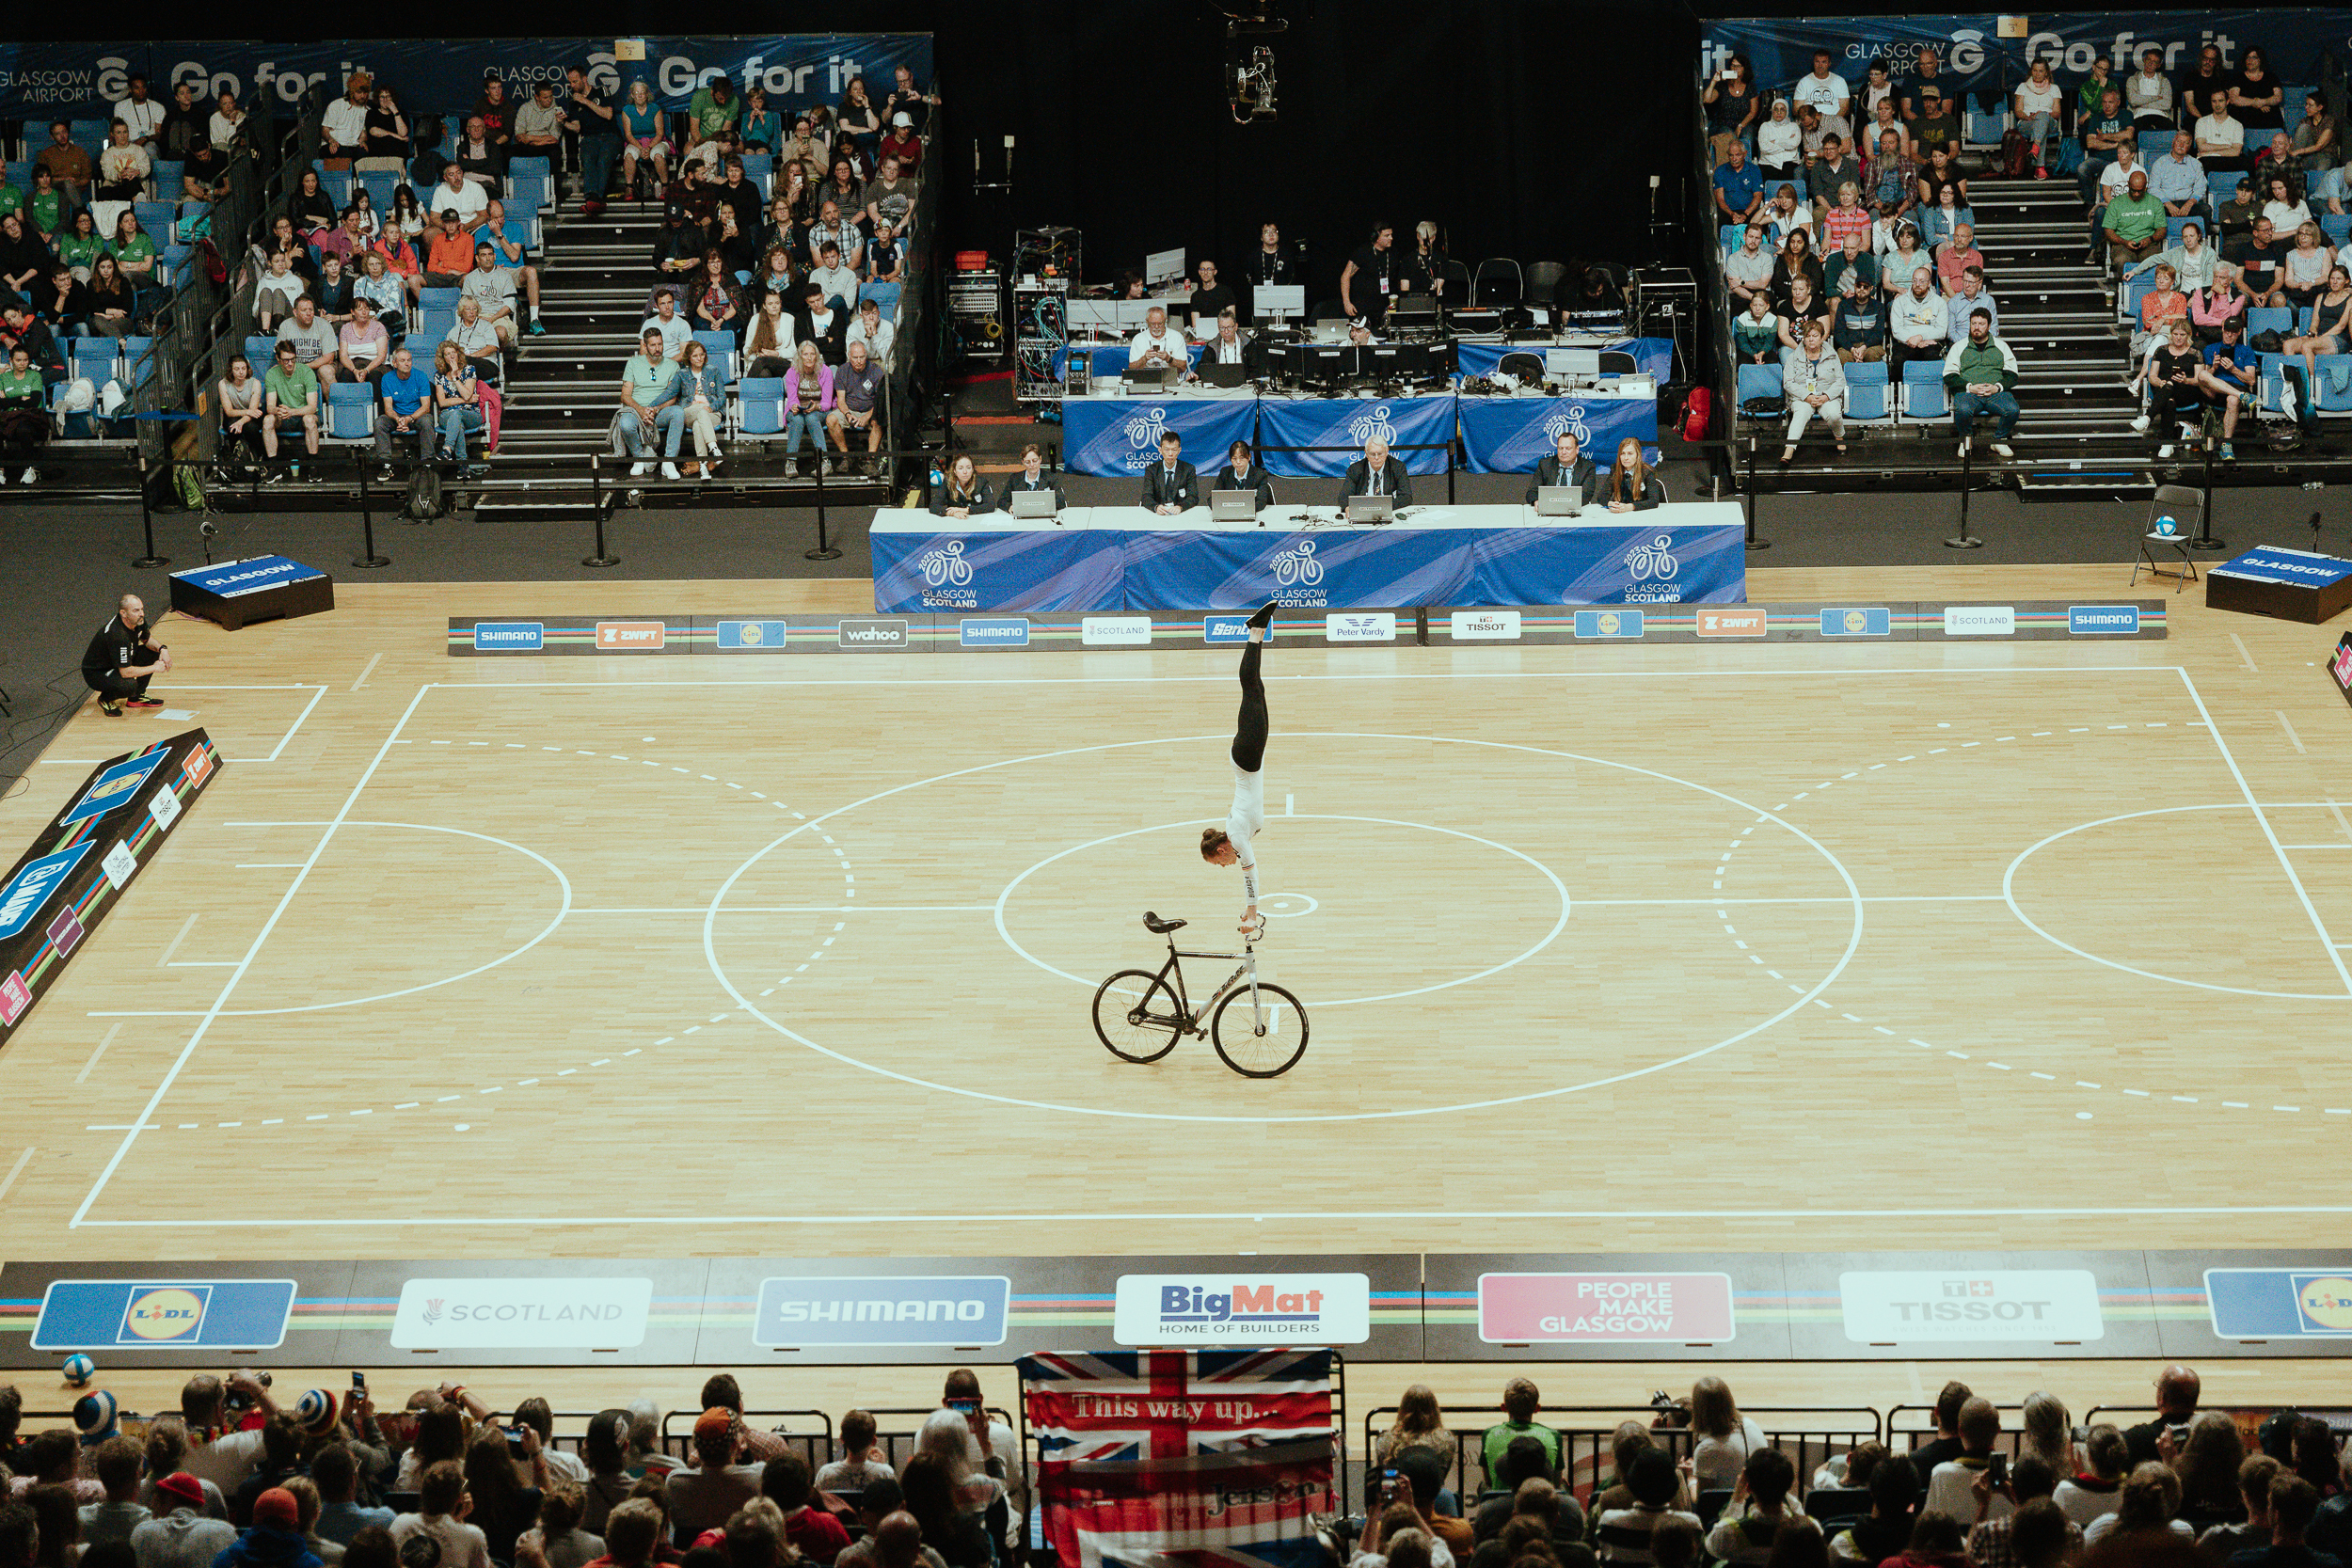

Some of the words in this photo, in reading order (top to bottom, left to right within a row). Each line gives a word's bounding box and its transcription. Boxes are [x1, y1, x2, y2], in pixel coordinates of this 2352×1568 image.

[2026, 32, 2096, 72] Go
[741, 56, 814, 94] for
[829, 55, 862, 94] it
[23, 87, 93, 103] AIRPORT
[1662, 306, 1670, 314] 2
[1123, 418, 1139, 436] 2023
[1348, 417, 1363, 436] 2023
[1543, 416, 1559, 435] 2023
[918, 551, 935, 572] 2023
[1269, 551, 1286, 572] 2023
[1624, 546, 1641, 567] 2023
[205, 563, 295, 586] GLASGOW
[2242, 558, 2340, 577] GLASGOW
[922, 589, 977, 599] GLASGOW
[1271, 589, 1327, 599] GLASGOW
[1624, 583, 1681, 594] GLASGOW
[923, 597, 977, 608] SCOTLAND
[1278, 598, 1327, 608] COTLAND
[1625, 594, 1681, 603] SCOTLAND
[1466, 623, 1506, 631] TISSOT
[1722, 618, 1758, 628] ZWIFT
[2075, 615, 2133, 625] SHIMANO
[481, 631, 537, 641] SHIMANO
[621, 630, 657, 641] ZWIFT
[847, 626, 900, 641] wahoo
[966, 627, 1023, 638] SHIMANO
[1360, 628, 1386, 637] Vardy
[1578, 1281, 1673, 1299] PEOPLE
[779, 1299, 986, 1323] SHIMANO
[1161, 1285, 1324, 1322] BigMat
[1598, 1299, 1674, 1315] MAKE
[1889, 1301, 2052, 1322] TISSOT
[451, 1304, 623, 1322] SCOTLAND
[1159, 1324, 1208, 1334] HOME
[1213, 1324, 1235, 1334] OF
[1240, 1323, 1320, 1334] BUILDERS
[1540, 1316, 1674, 1333] GLASGOW
[1071, 1393, 1138, 1419] This
[1145, 1395, 1207, 1425] way
